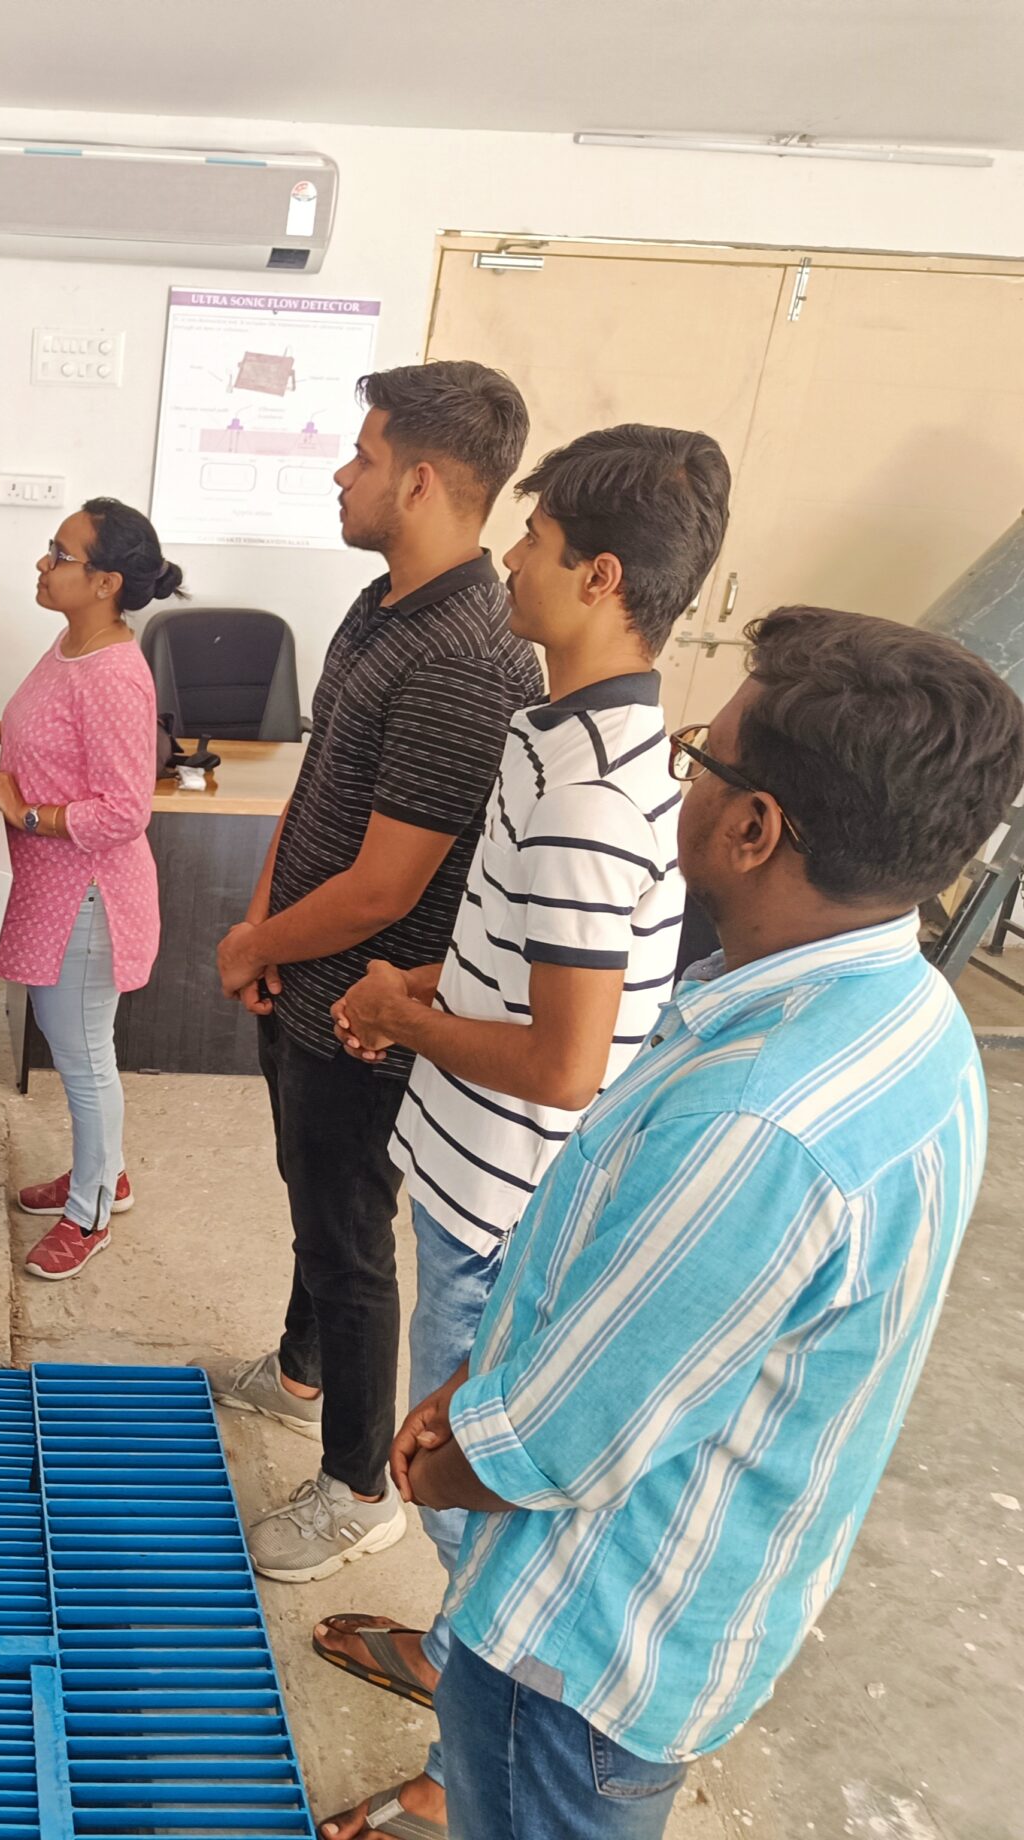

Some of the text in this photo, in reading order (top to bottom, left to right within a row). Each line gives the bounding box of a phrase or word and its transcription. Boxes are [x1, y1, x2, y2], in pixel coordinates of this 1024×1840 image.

[191, 294, 360, 312] ULTRA SONIC FLOW DETECTOR
